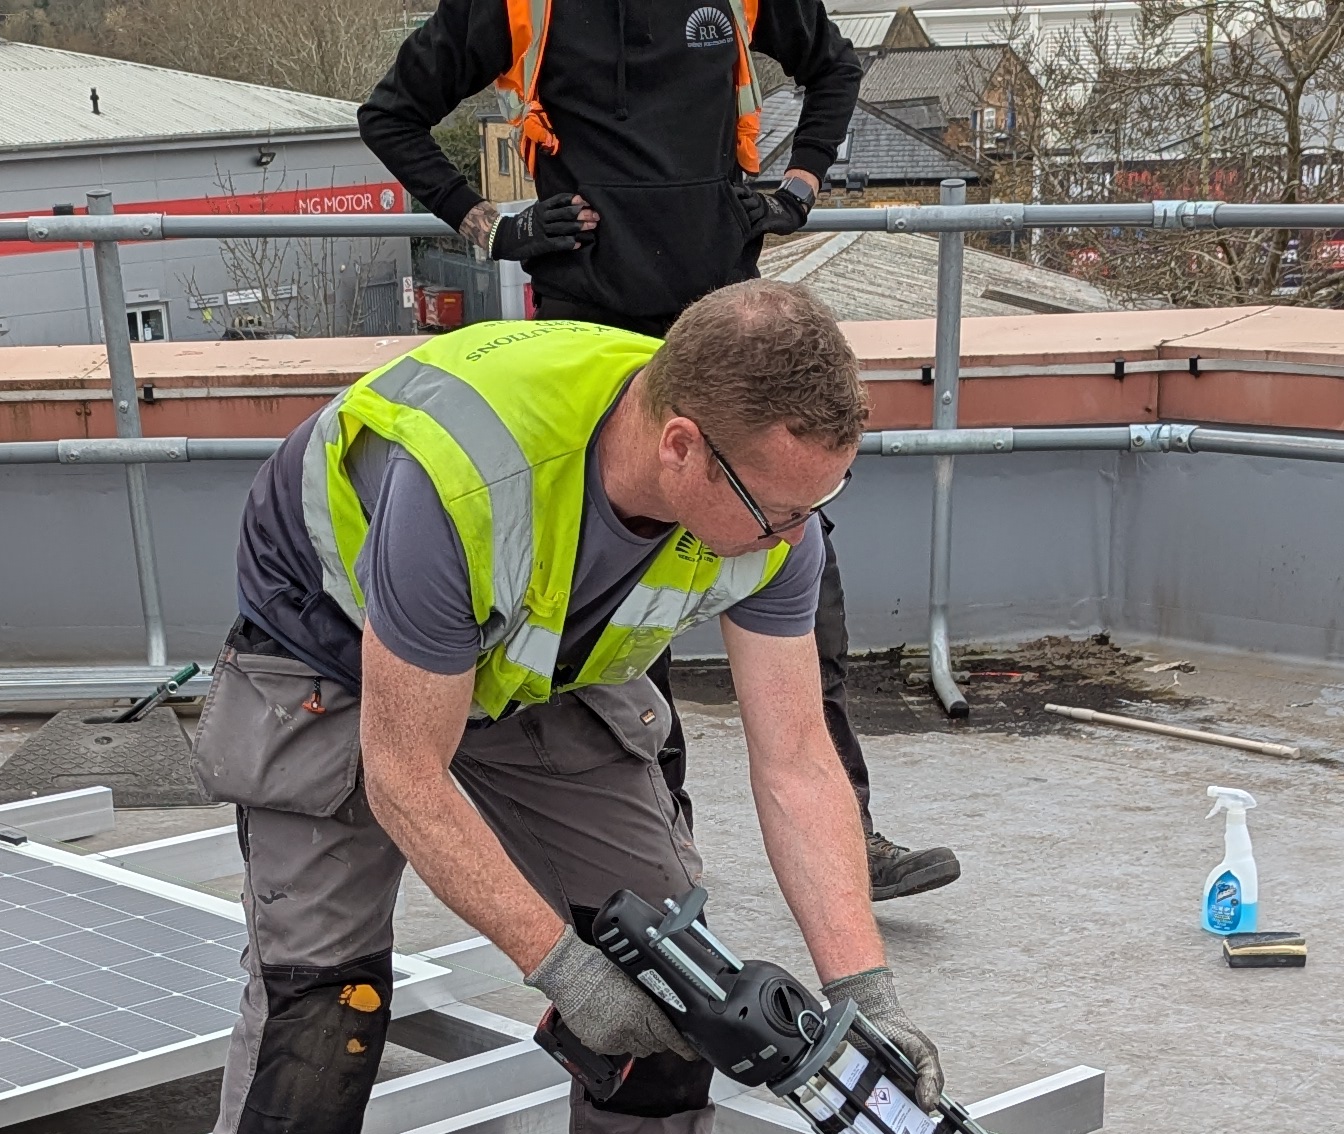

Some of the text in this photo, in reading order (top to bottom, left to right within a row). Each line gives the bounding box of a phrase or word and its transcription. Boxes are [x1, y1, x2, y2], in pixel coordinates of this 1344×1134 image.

[699, 25, 719, 40] RR
[299, 194, 374, 215] MG MOTOR
